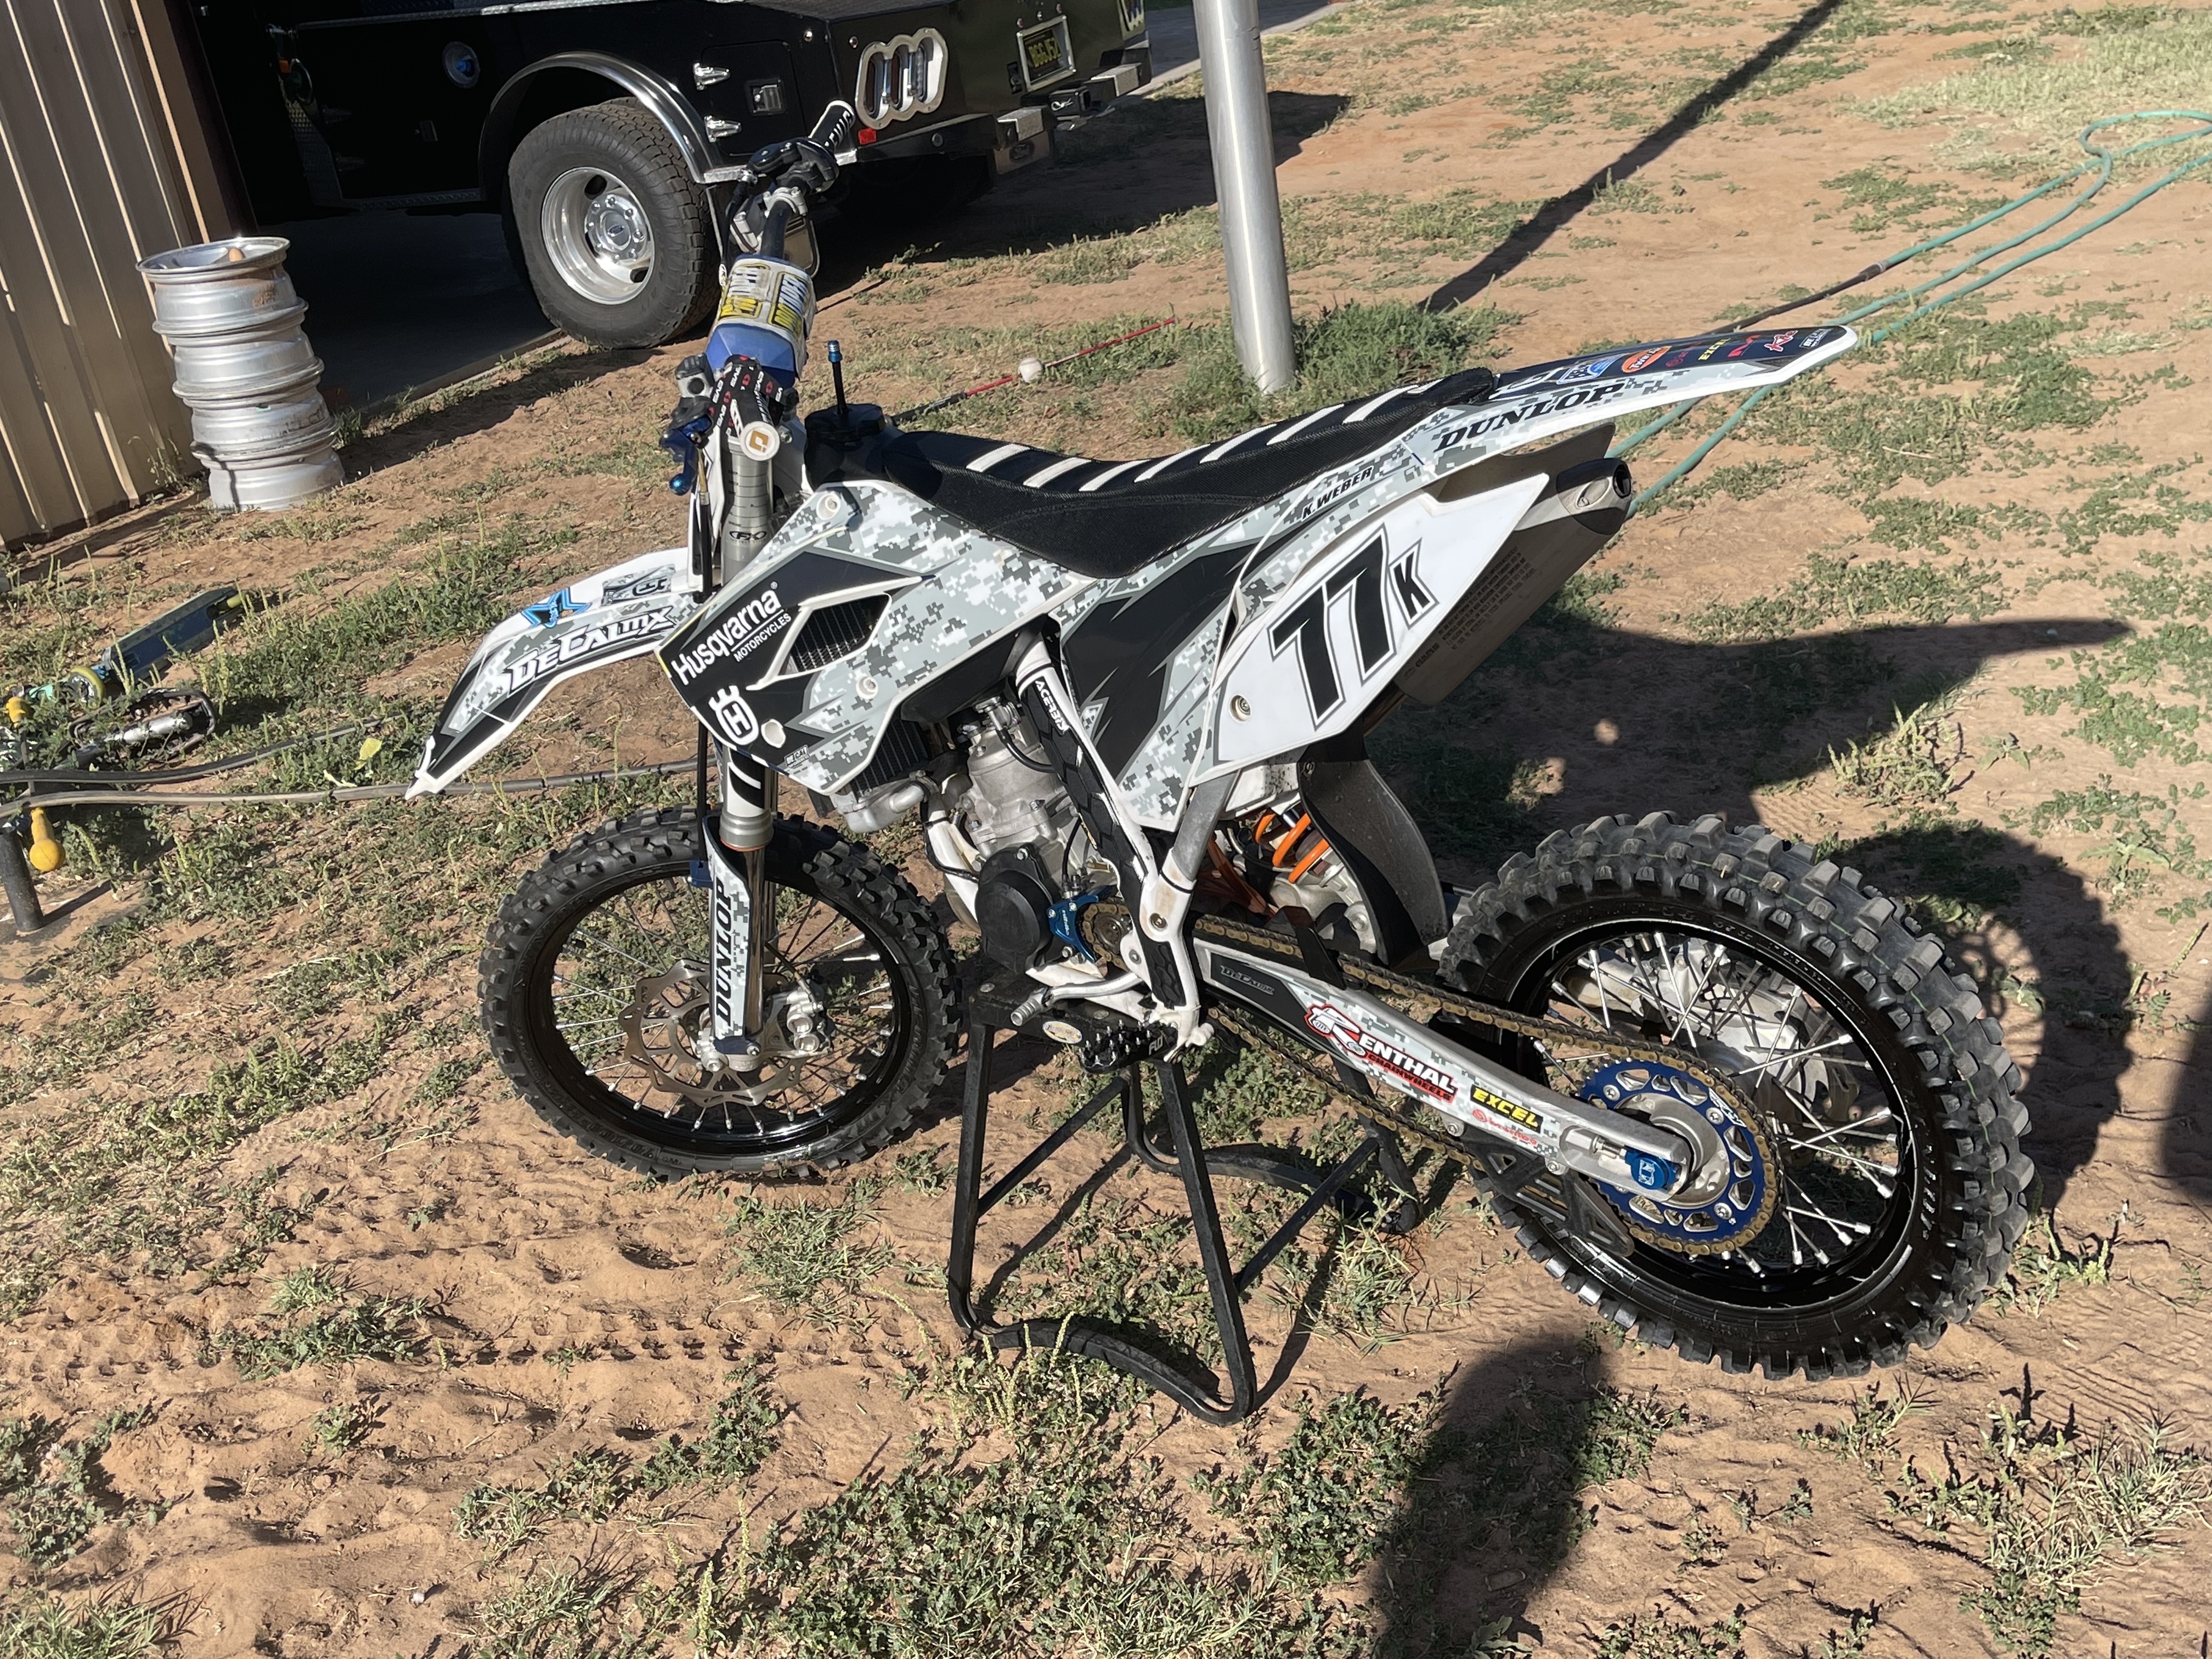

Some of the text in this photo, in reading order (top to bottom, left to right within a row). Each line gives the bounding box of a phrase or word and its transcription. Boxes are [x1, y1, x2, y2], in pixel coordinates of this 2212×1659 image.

[1433, 383, 1625, 453] DUNLOP
[670, 590, 782, 685] Husqvarna
[733, 613, 792, 662] MOTORCYCLES
[715, 876, 732, 1026] DUNLOP
[1472, 1087, 1538, 1128] EXCEL
